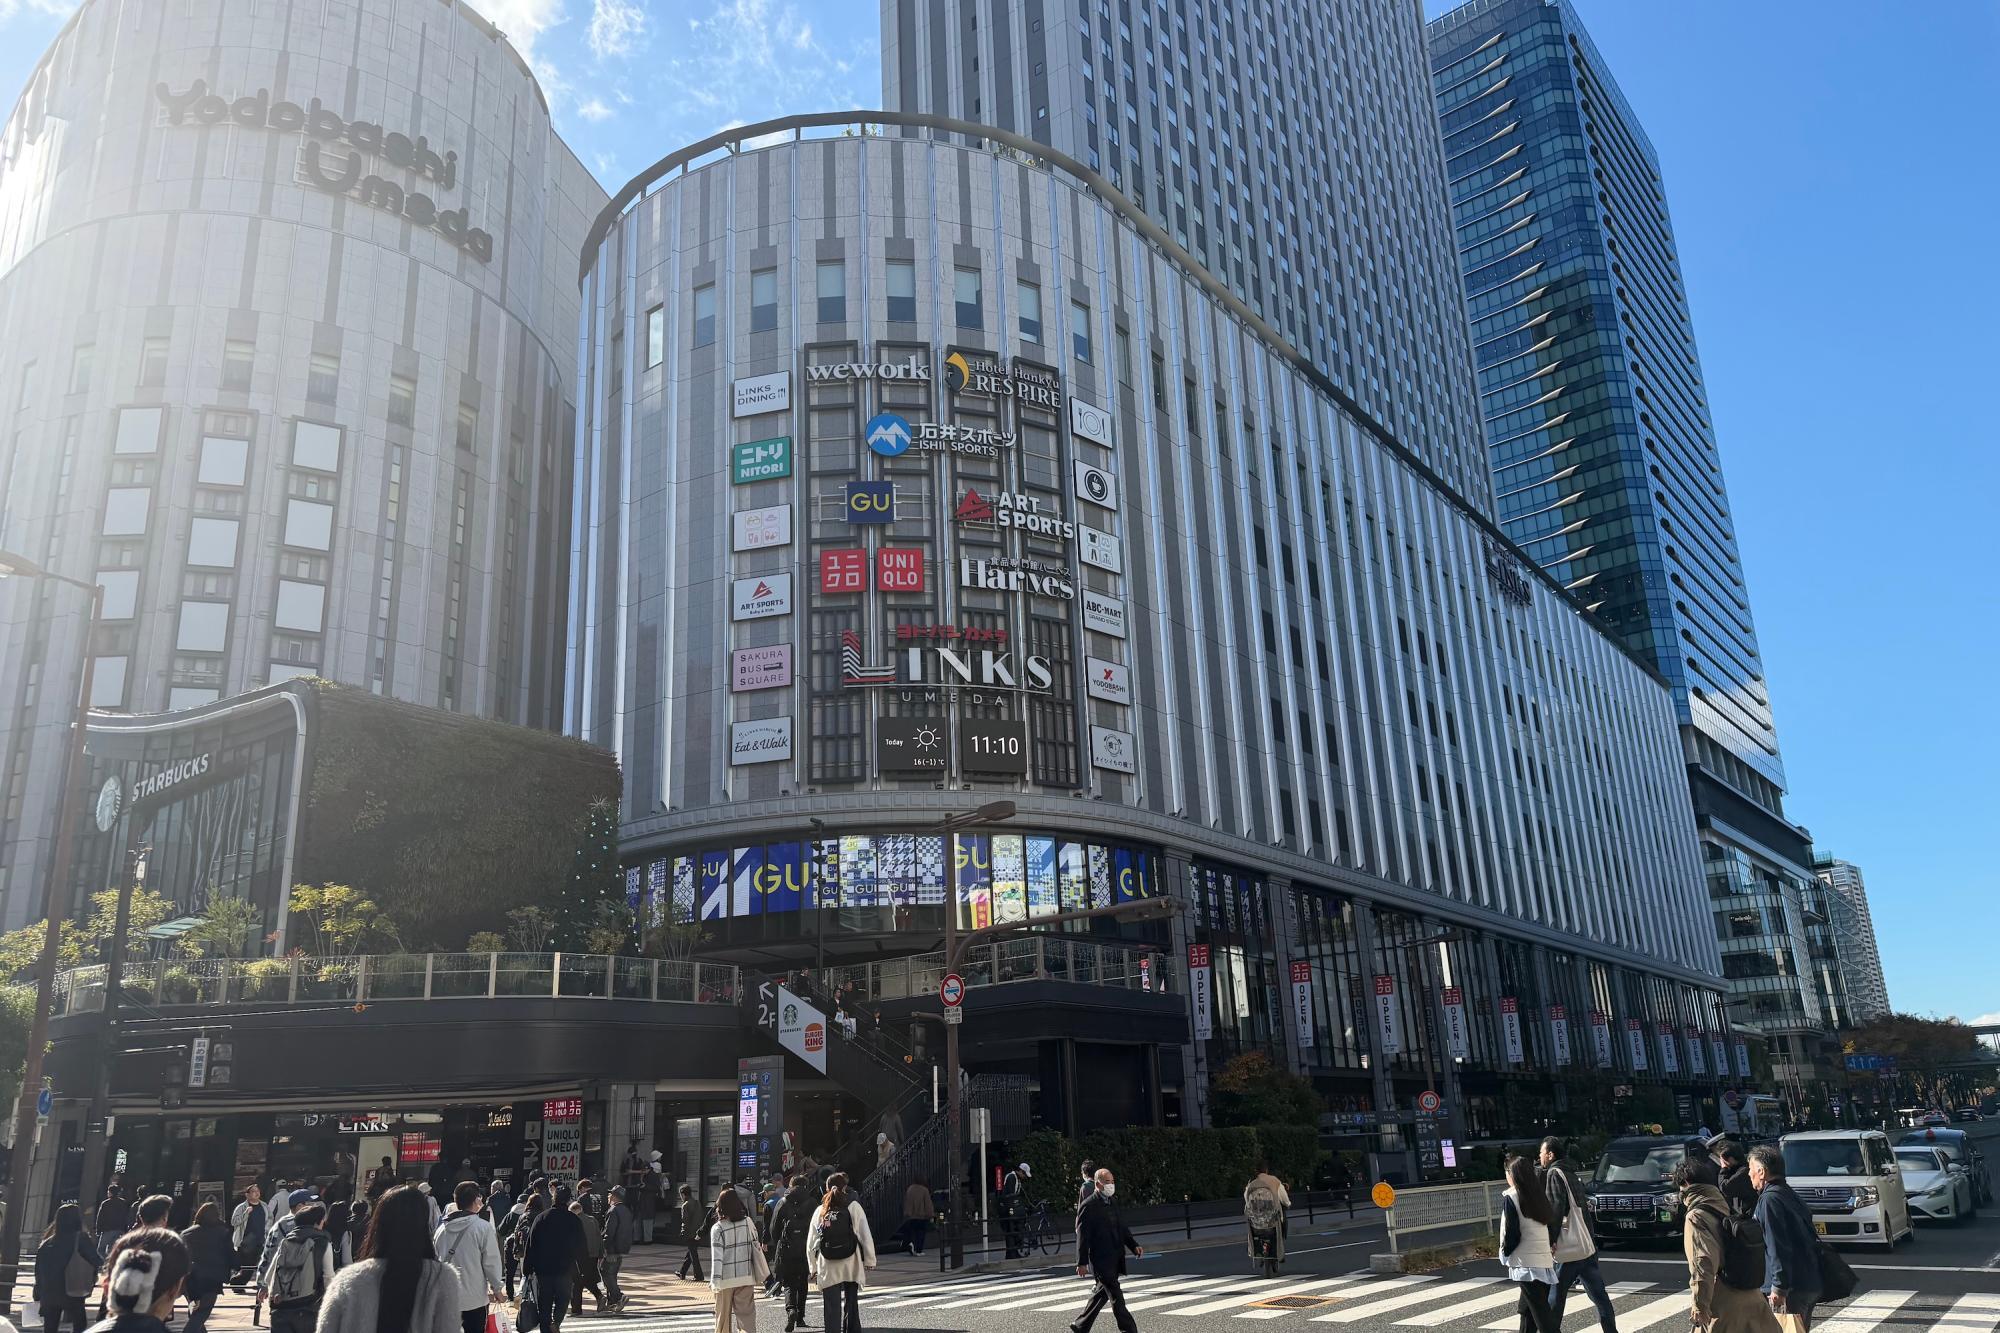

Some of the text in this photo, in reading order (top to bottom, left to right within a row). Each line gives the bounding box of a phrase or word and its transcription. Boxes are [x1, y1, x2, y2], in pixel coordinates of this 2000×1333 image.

[155, 78, 458, 190] Yodobashi
[306, 141, 493, 264] Umeda
[806, 355, 930, 380] wework
[975, 361, 1059, 389] Hotel Hankyu
[738, 384, 771, 396] LINKS
[976, 375, 1061, 408] RESPIRE
[738, 393, 776, 405] DINING
[919, 422, 1017, 448] 石井スポーツ
[740, 442, 783, 466] ニトリ
[919, 440, 999, 456] ISHII SPORTS
[740, 462, 783, 478] NITORI
[850, 492, 890, 512] GU
[998, 492, 1041, 514] ART
[998, 510, 1075, 539] SPORTS
[827, 554, 858, 570] ユニ
[882, 553, 915, 569] UNI
[826, 571, 860, 587] クロ
[883, 571, 918, 588] QLO
[961, 558, 1075, 600] Harves
[740, 599, 784, 611] ART SPORTS
[1086, 600, 1122, 619] ABC-MART
[896, 624, 1009, 644] ヨドバシカメラ
[740, 650, 783, 662] SAKURA
[842, 629, 1053, 689] LINKS
[740, 664, 762, 674] BUS
[740, 674, 784, 686] SQUARE
[1092, 679, 1126, 693] YODOBASHI
[901, 691, 1004, 706] UMEDA
[734, 735, 788, 752] Eat & Walk
[885, 738, 904, 747] Today
[971, 736, 1019, 755] 11:10
[132, 753, 209, 802] STARBUCKS
[953, 845, 988, 869] GU
[753, 863, 809, 894] GU
[822, 887, 838, 895] GU
[854, 884, 874, 894] GU
[890, 883, 908, 893] GU
[1197, 970, 1205, 1027] OPEN!
[758, 1003, 776, 1029] 2F
[1299, 985, 1307, 1036] OPEN!
[1382, 997, 1392, 1043] OPEN!
[1450, 1007, 1460, 1049] OPEN!
[804, 1031, 824, 1039] BURGER
[804, 1037, 824, 1047] KING
[1508, 1015, 1517, 1054] OPEN!
[1556, 1021, 1566, 1056] OPEN!
[1633, 1032, 1642, 1063] OPEN!
[741, 1072, 757, 1083] 立体
[741, 1087, 757, 1098] 空車
[1424, 1097, 1435, 1106] 40
[339, 1118, 389, 1131] LINKS
[547, 1129, 580, 1140] UNIQLO
[546, 1142, 579, 1153] UMEDA
[546, 1155, 575, 1171] 10.24
